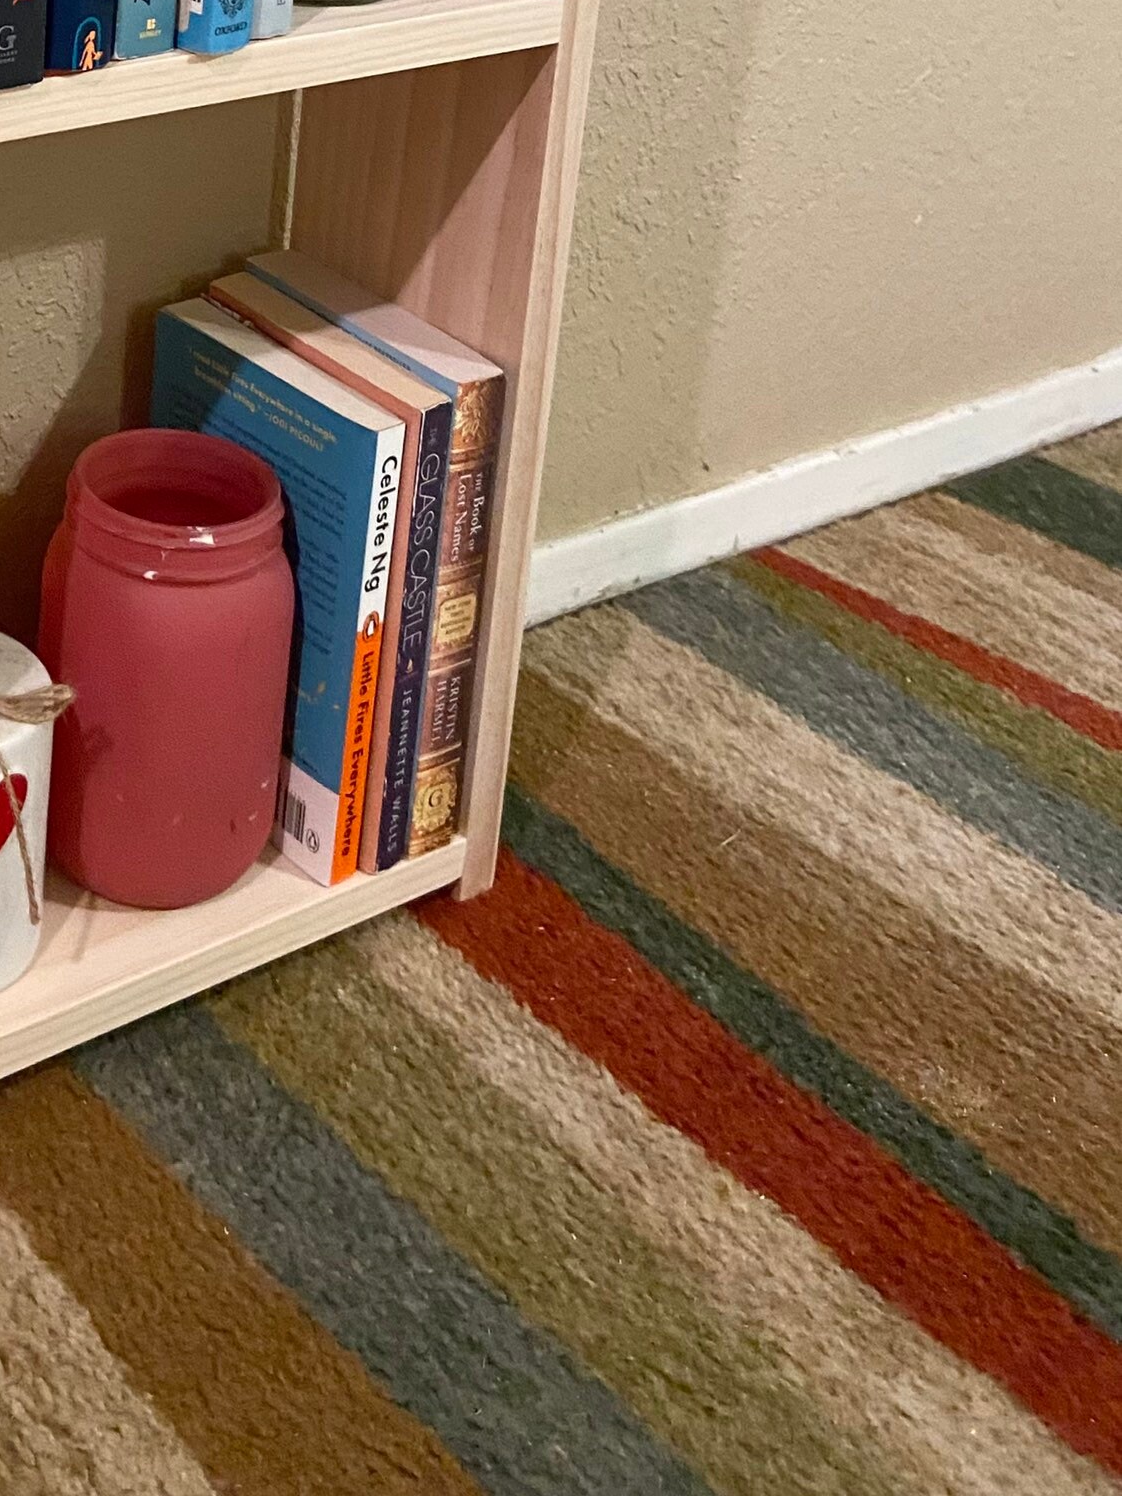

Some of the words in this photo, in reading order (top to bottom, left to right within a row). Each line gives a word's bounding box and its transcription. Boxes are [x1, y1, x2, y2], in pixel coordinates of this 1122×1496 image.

[374, 455, 398, 547] Celeste
[414, 453, 440, 545] GLASS
[470, 496, 485, 536] Book
[451, 510, 468, 562] Names
[364, 554, 386, 593] Ng
[403, 549, 430, 651] CASTLE
[359, 650, 375, 696] Little
[353, 701, 370, 744] Fires
[394, 688, 413, 790] JEANNETTE
[445, 676, 461, 741] KRISTIN
[342, 750, 364, 856] Everywhere
[387, 795, 402, 853] WALLS
